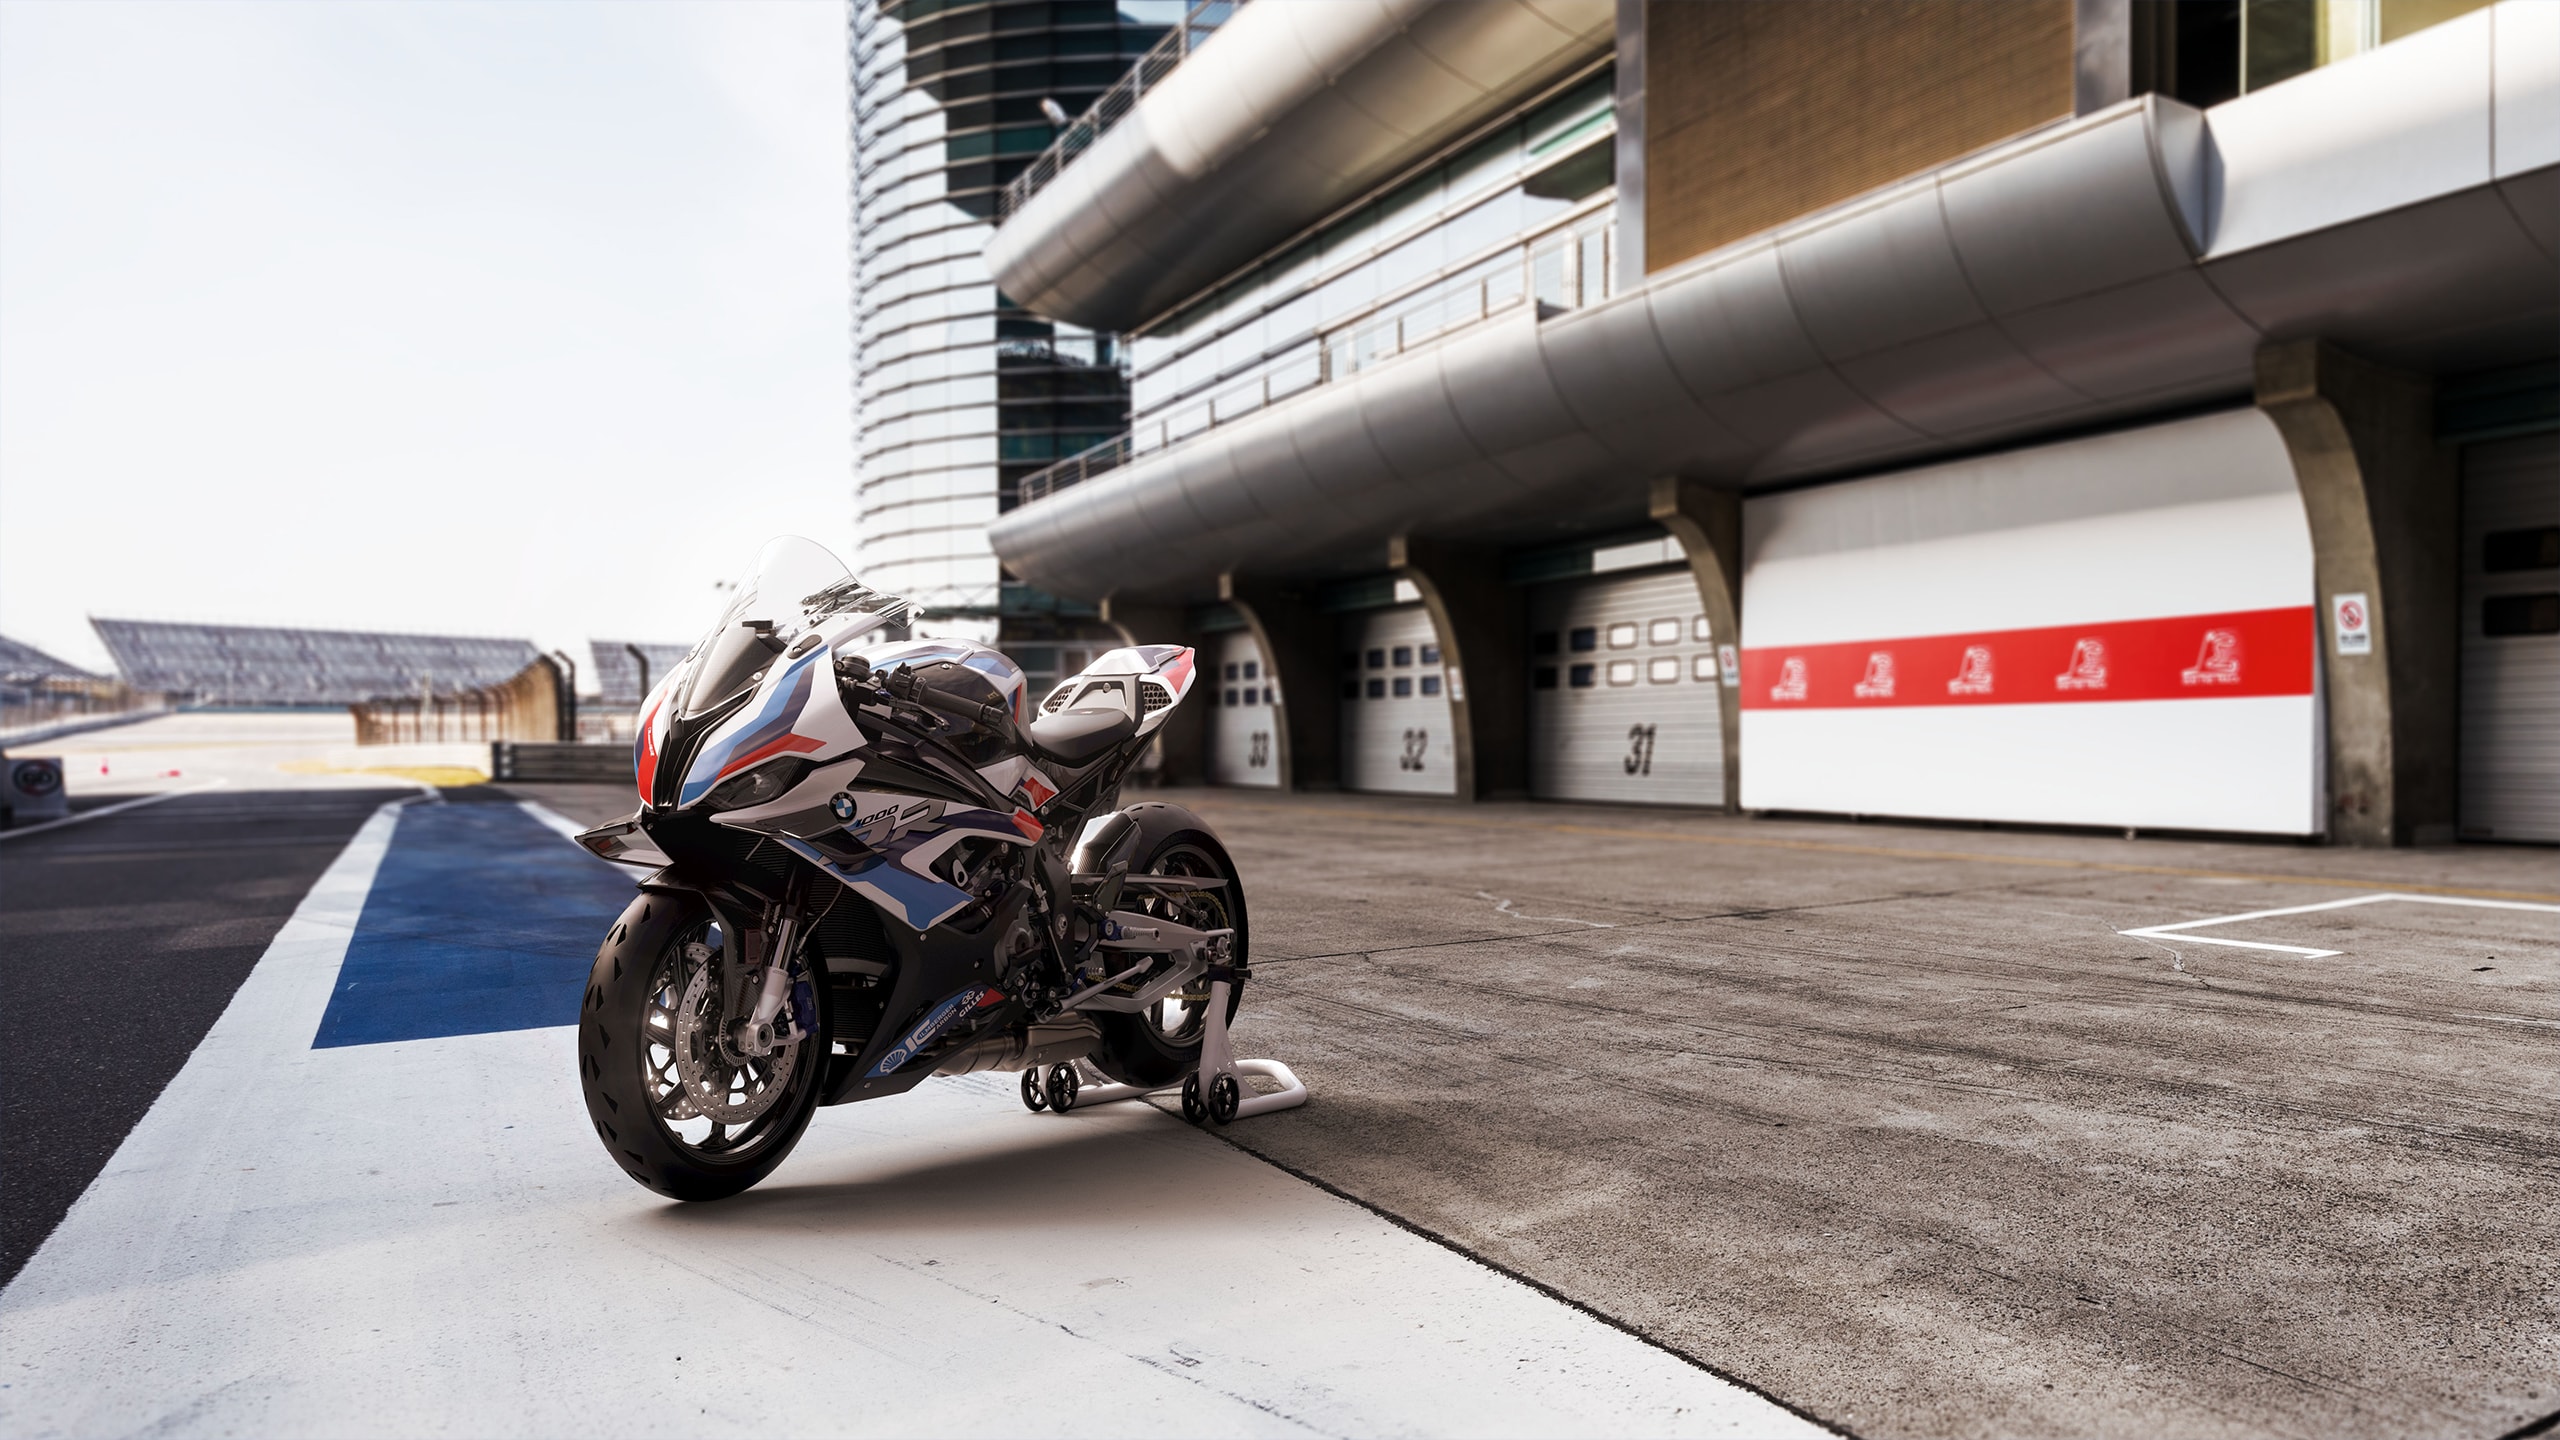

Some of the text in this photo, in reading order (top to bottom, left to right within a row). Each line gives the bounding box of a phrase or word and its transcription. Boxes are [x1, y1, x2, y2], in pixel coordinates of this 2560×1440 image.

[1249, 731, 1269, 768] 33
[1400, 729, 1427, 772] 32
[1624, 723, 1657, 776] 31
[855, 804, 899, 827] 1000
[959, 991, 984, 1017] GILLES
